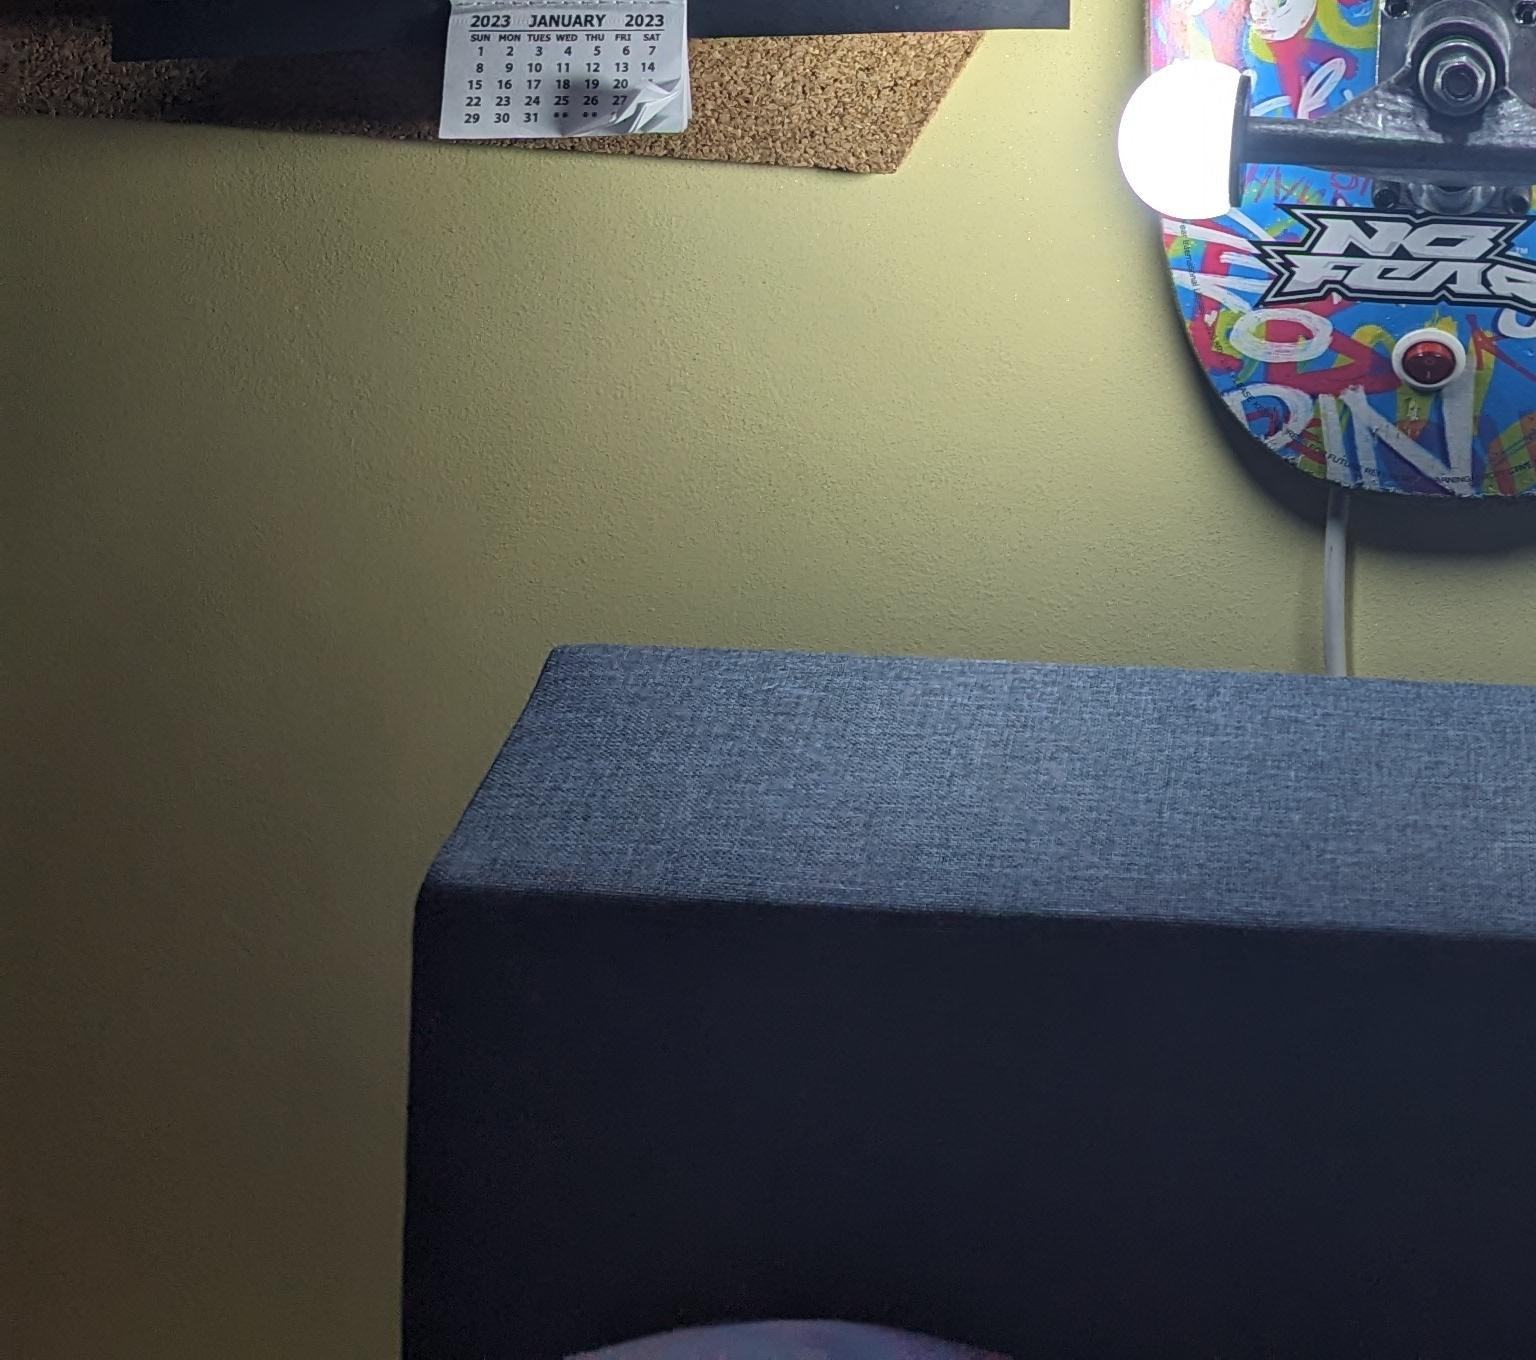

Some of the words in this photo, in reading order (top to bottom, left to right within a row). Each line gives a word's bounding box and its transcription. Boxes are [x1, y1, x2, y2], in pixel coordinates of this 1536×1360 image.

[470, 14, 511, 28] 2023
[528, 14, 607, 28] JANUARY
[624, 14, 665, 28] 2023
[470, 33, 491, 43] SUN
[499, 33, 521, 43] MON
[527, 33, 551, 43] TUES
[556, 33, 578, 43] WED
[585, 33, 605, 43] THU
[615, 33, 632, 43] FRI
[643, 33, 660, 43] SAT
[478, 46, 483, 56] 1
[506, 46, 514, 56] 2
[535, 46, 543, 56] 3
[564, 46, 572, 56] 4
[594, 46, 601, 56] 5
[622, 46, 630, 56] 6
[649, 46, 656, 56] 7
[476, 63, 484, 73] 8
[505, 63, 513, 73] 9
[528, 63, 542, 73] 10
[556, 63, 570, 73] 11
[586, 63, 600, 73] 12
[615, 63, 629, 73] 13
[641, 63, 655, 73] 14
[468, 80, 482, 90] 15
[497, 80, 512, 90] 16
[527, 80, 541, 90] 17
[556, 80, 570, 90] 18
[585, 80, 599, 90] 19
[613, 80, 628, 90] 20
[465, 96, 481, 106] 22
[496, 96, 511, 106] 23
[524, 96, 540, 106] 24
[554, 96, 569, 106] 25
[583, 96, 598, 106] 26
[612, 96, 627, 106] 27
[464, 113, 480, 123] 29
[494, 113, 510, 123] 30
[523, 113, 538, 123] 31
[1308, 216, 1500, 261] NO
